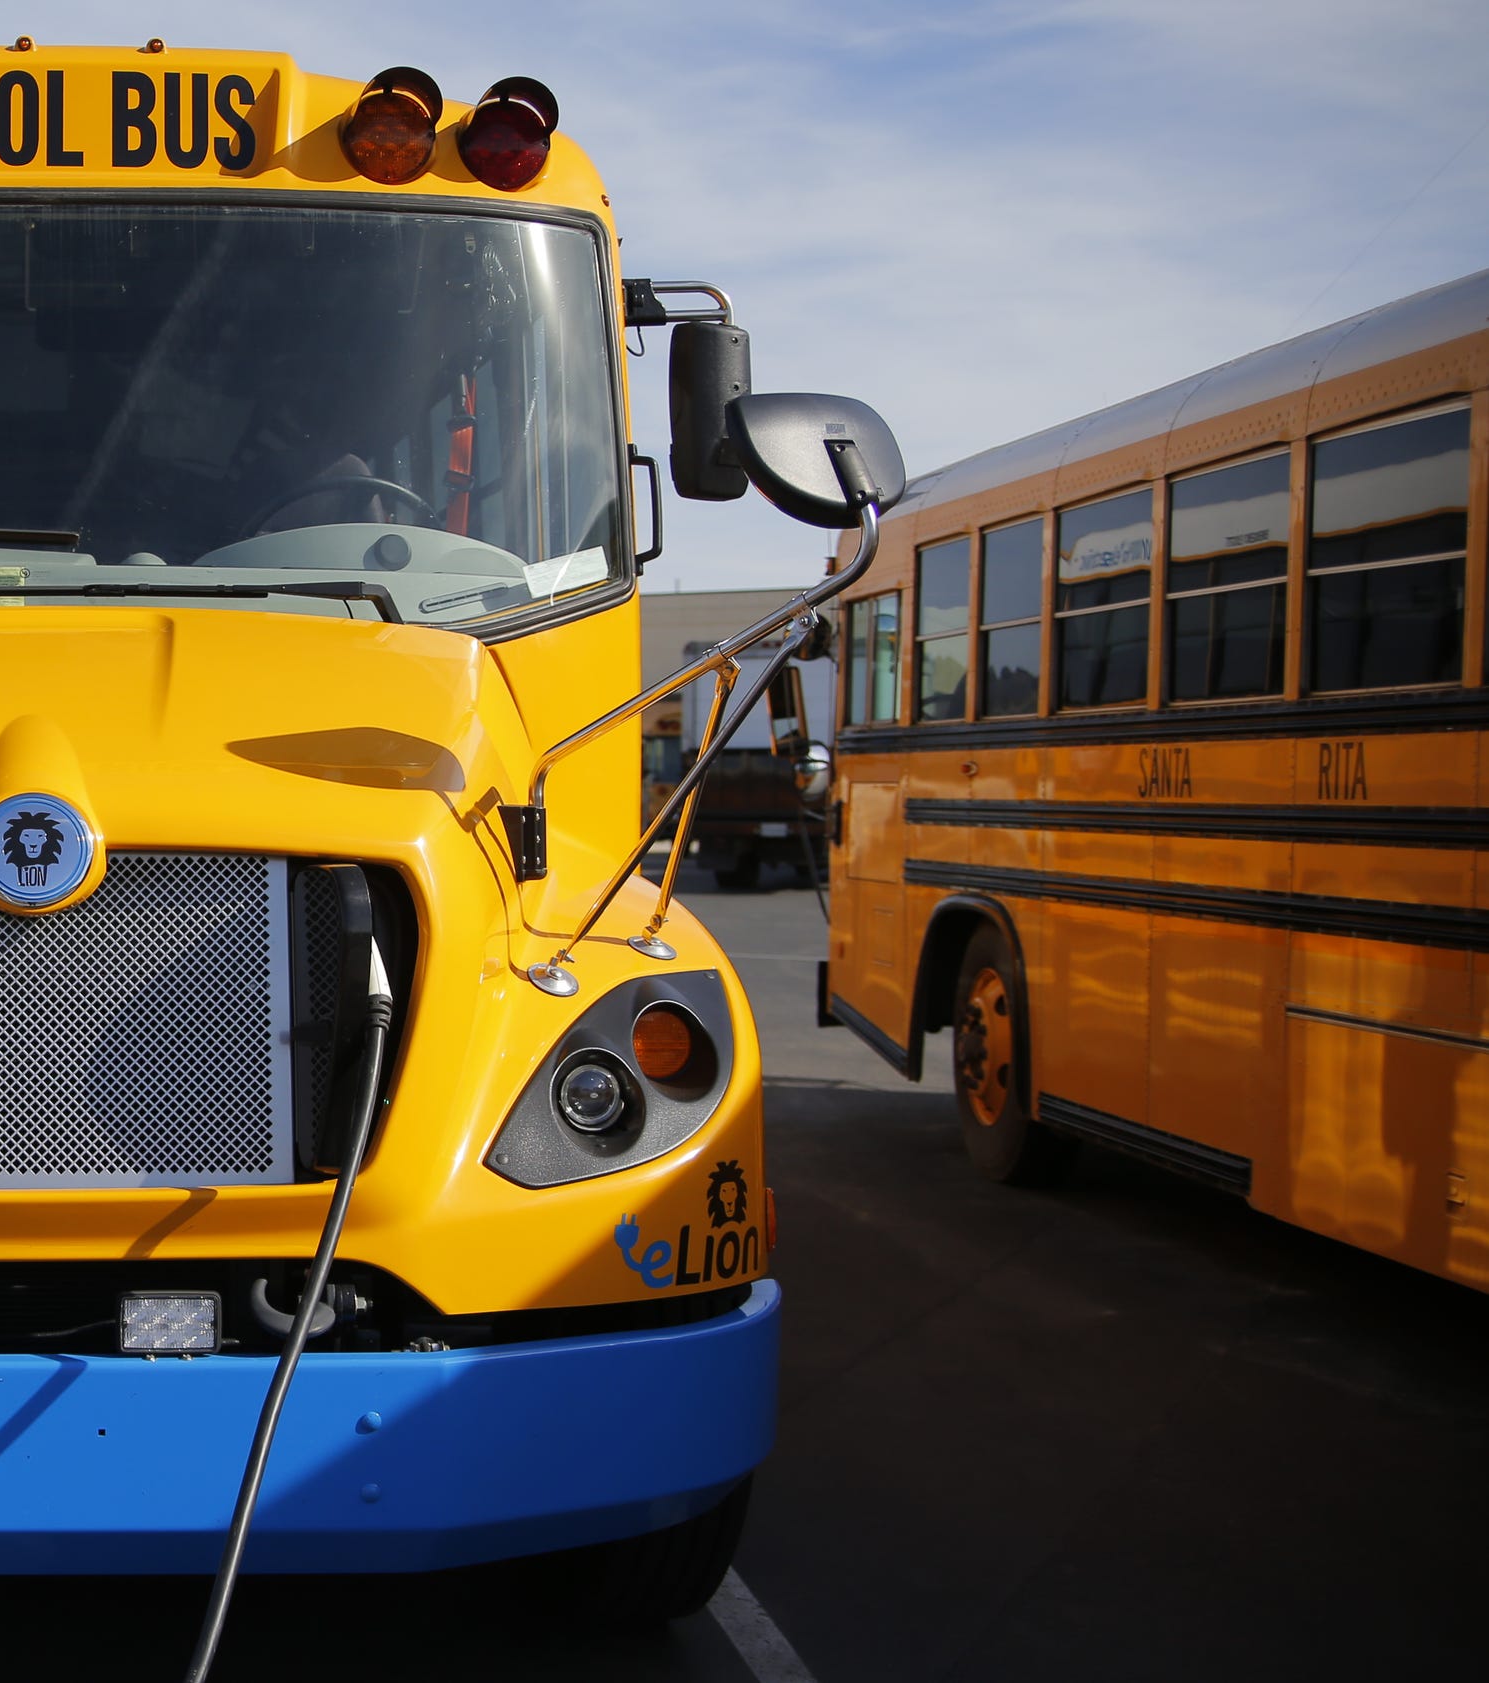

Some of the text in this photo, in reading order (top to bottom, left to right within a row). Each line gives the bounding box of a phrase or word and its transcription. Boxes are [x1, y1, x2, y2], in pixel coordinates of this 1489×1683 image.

[112, 71, 256, 171] BUS
[1137, 742, 1367, 800] SANTA RITA
